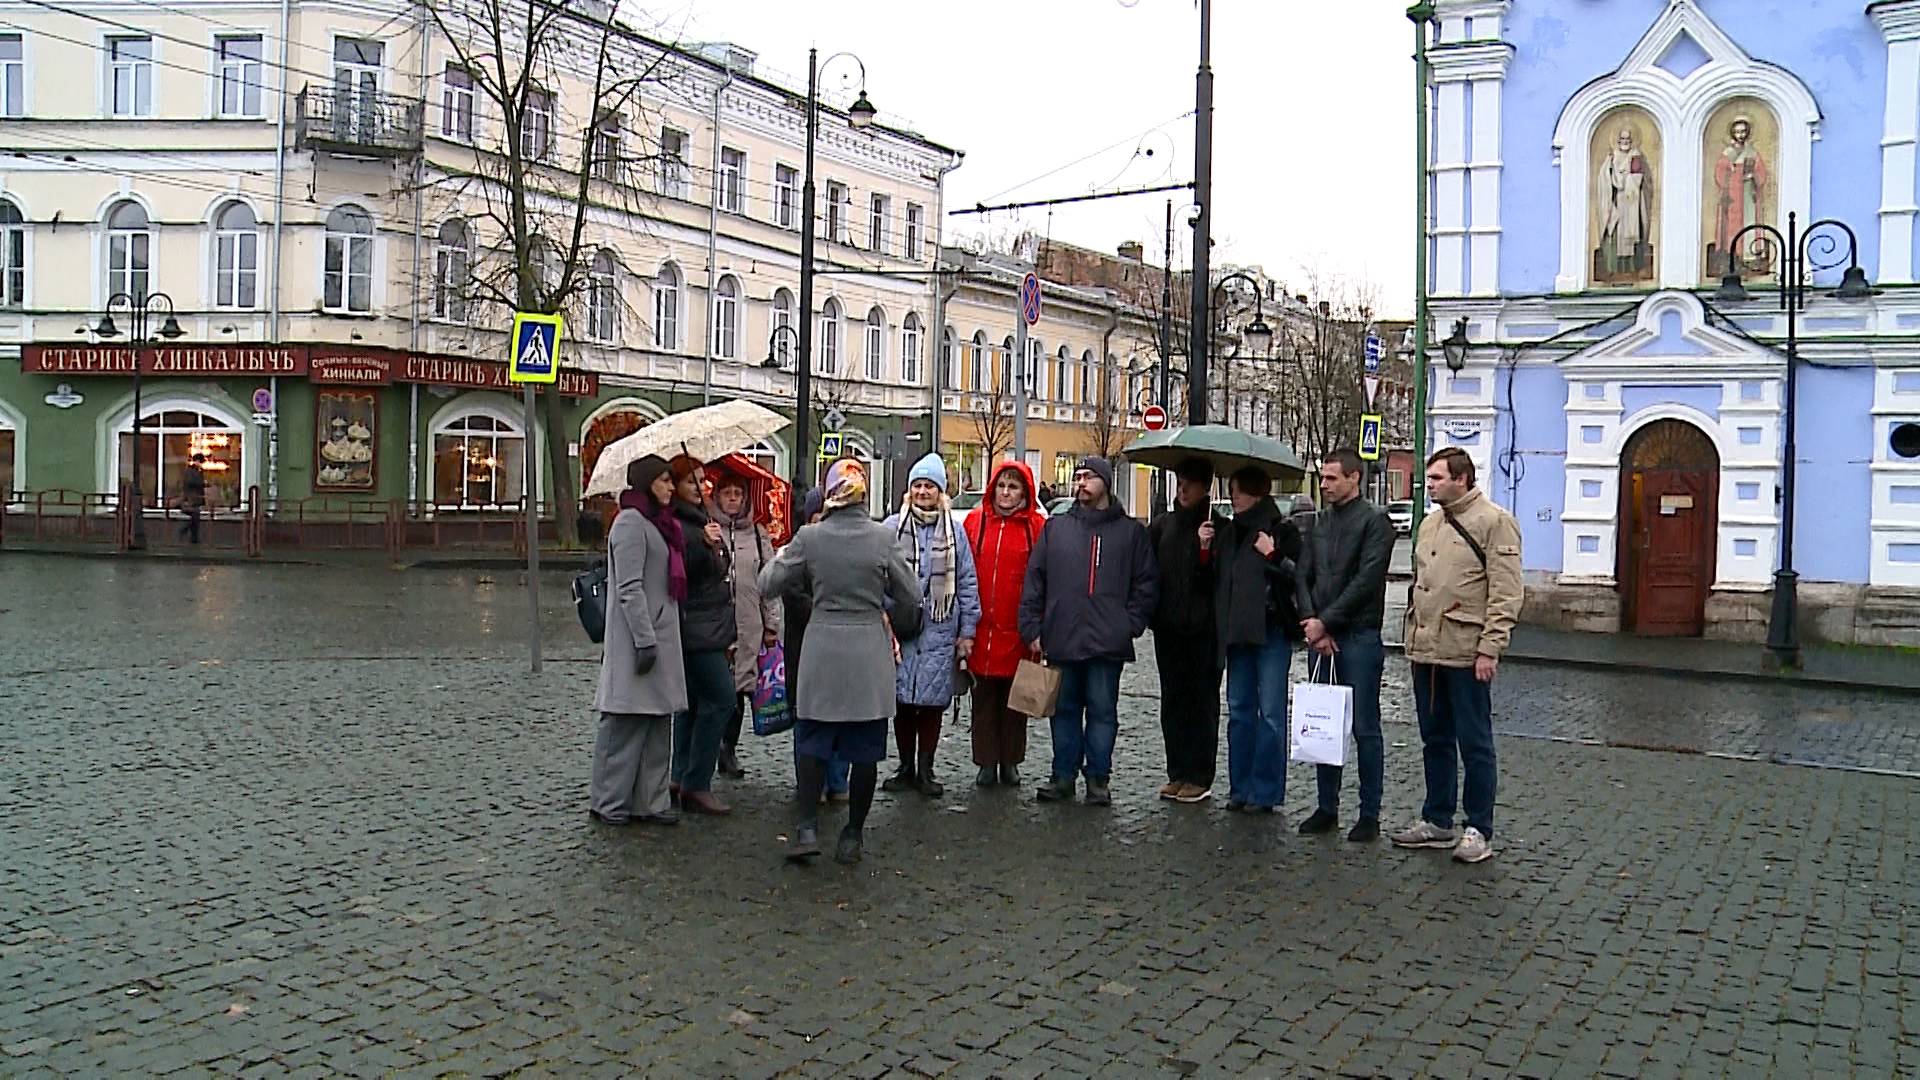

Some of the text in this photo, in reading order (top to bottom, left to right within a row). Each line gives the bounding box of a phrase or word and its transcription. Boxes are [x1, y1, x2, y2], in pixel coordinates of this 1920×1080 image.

[153, 349, 294, 370] ХИНКАЛЫЧЪ
[322, 367, 381, 380] ХИНКАЛИ
[407, 357, 485, 384] СТАРИКЪ
